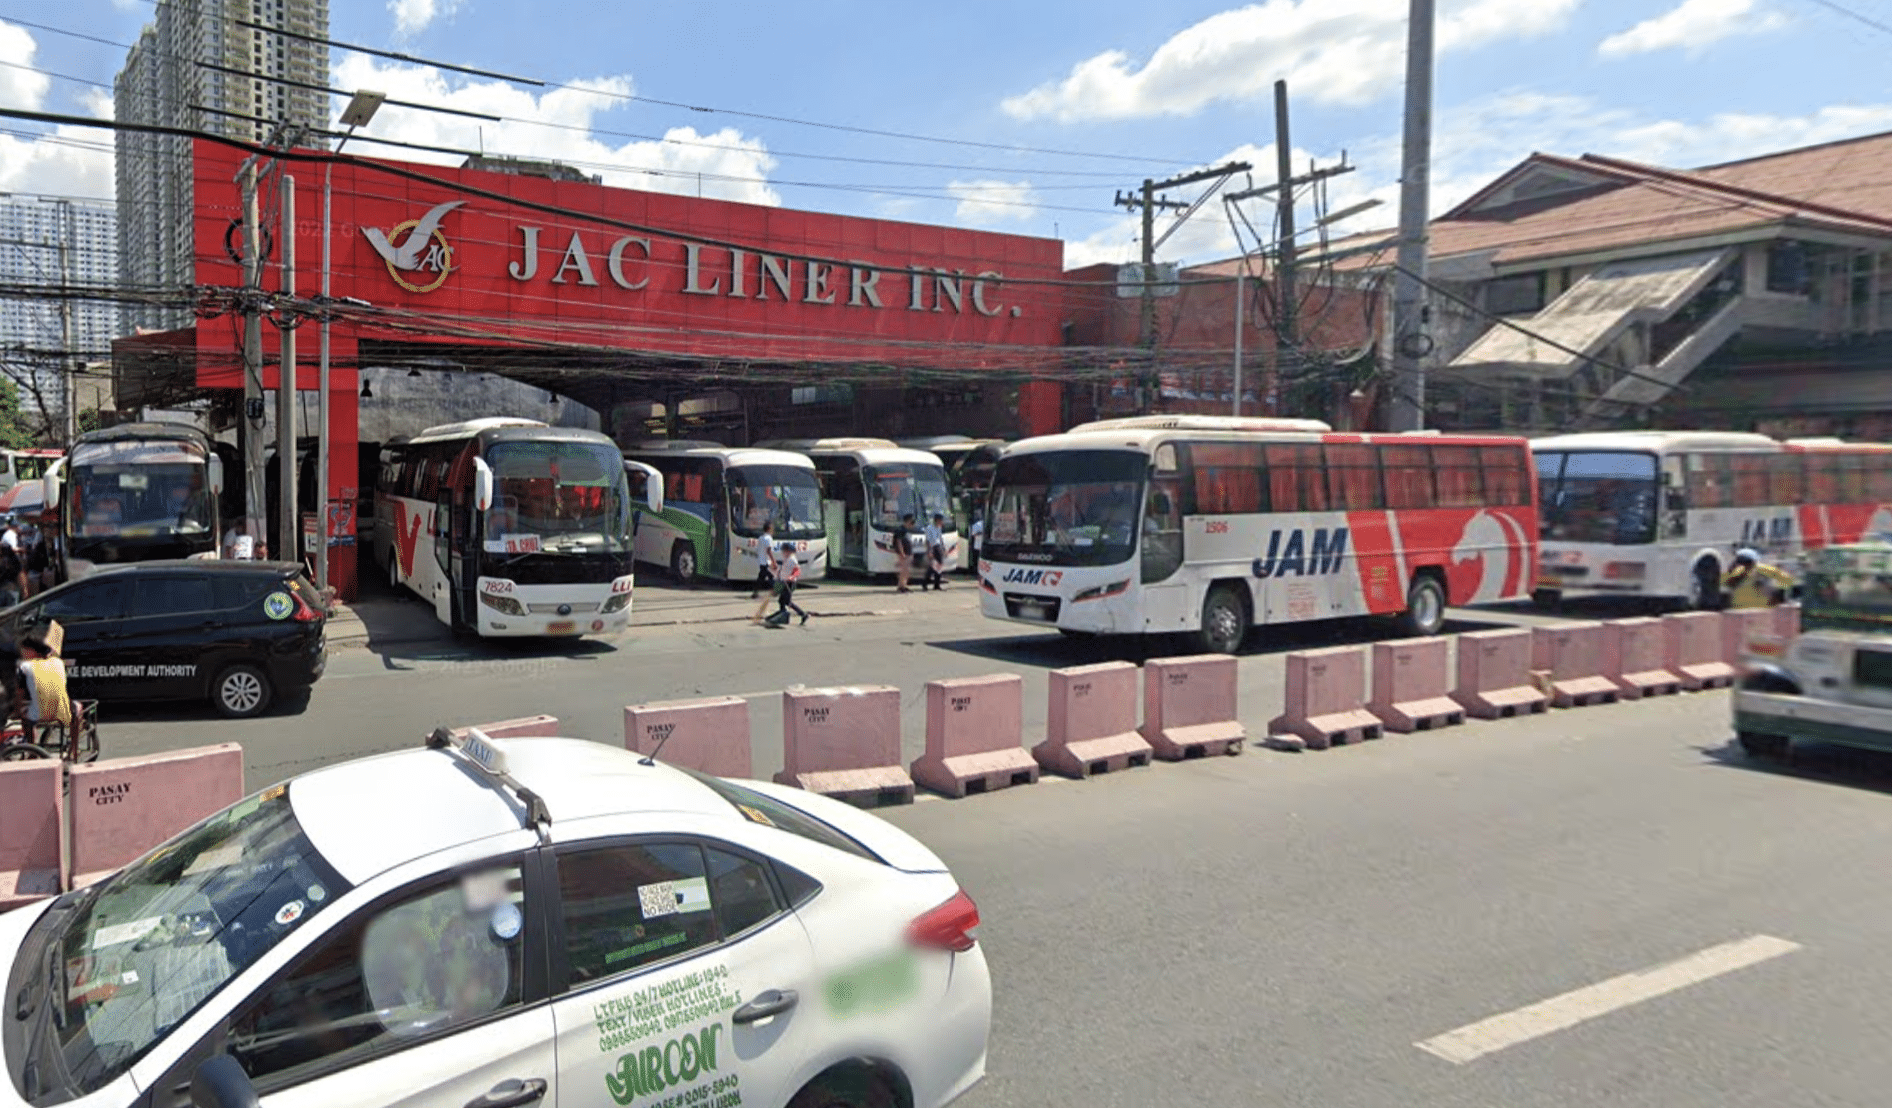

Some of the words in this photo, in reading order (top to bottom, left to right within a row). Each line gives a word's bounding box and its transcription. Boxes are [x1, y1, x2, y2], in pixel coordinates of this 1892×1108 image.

[509, 225, 652, 290] JAC
[681, 243, 885, 311] LINER
[906, 264, 1022, 317] INC.
[1252, 527, 1349, 579] JAM
[1002, 568, 1043, 585] JAM
[485, 581, 512, 593] 7824
[82, 664, 146, 677] DEVELOPMENT
[147, 664, 198, 677] AUTHORITY
[464, 737, 493, 763] TAXI
[89, 783, 131, 798] PASAY
[96, 794, 124, 805] CITY
[605, 1022, 723, 1105] AIRCON
